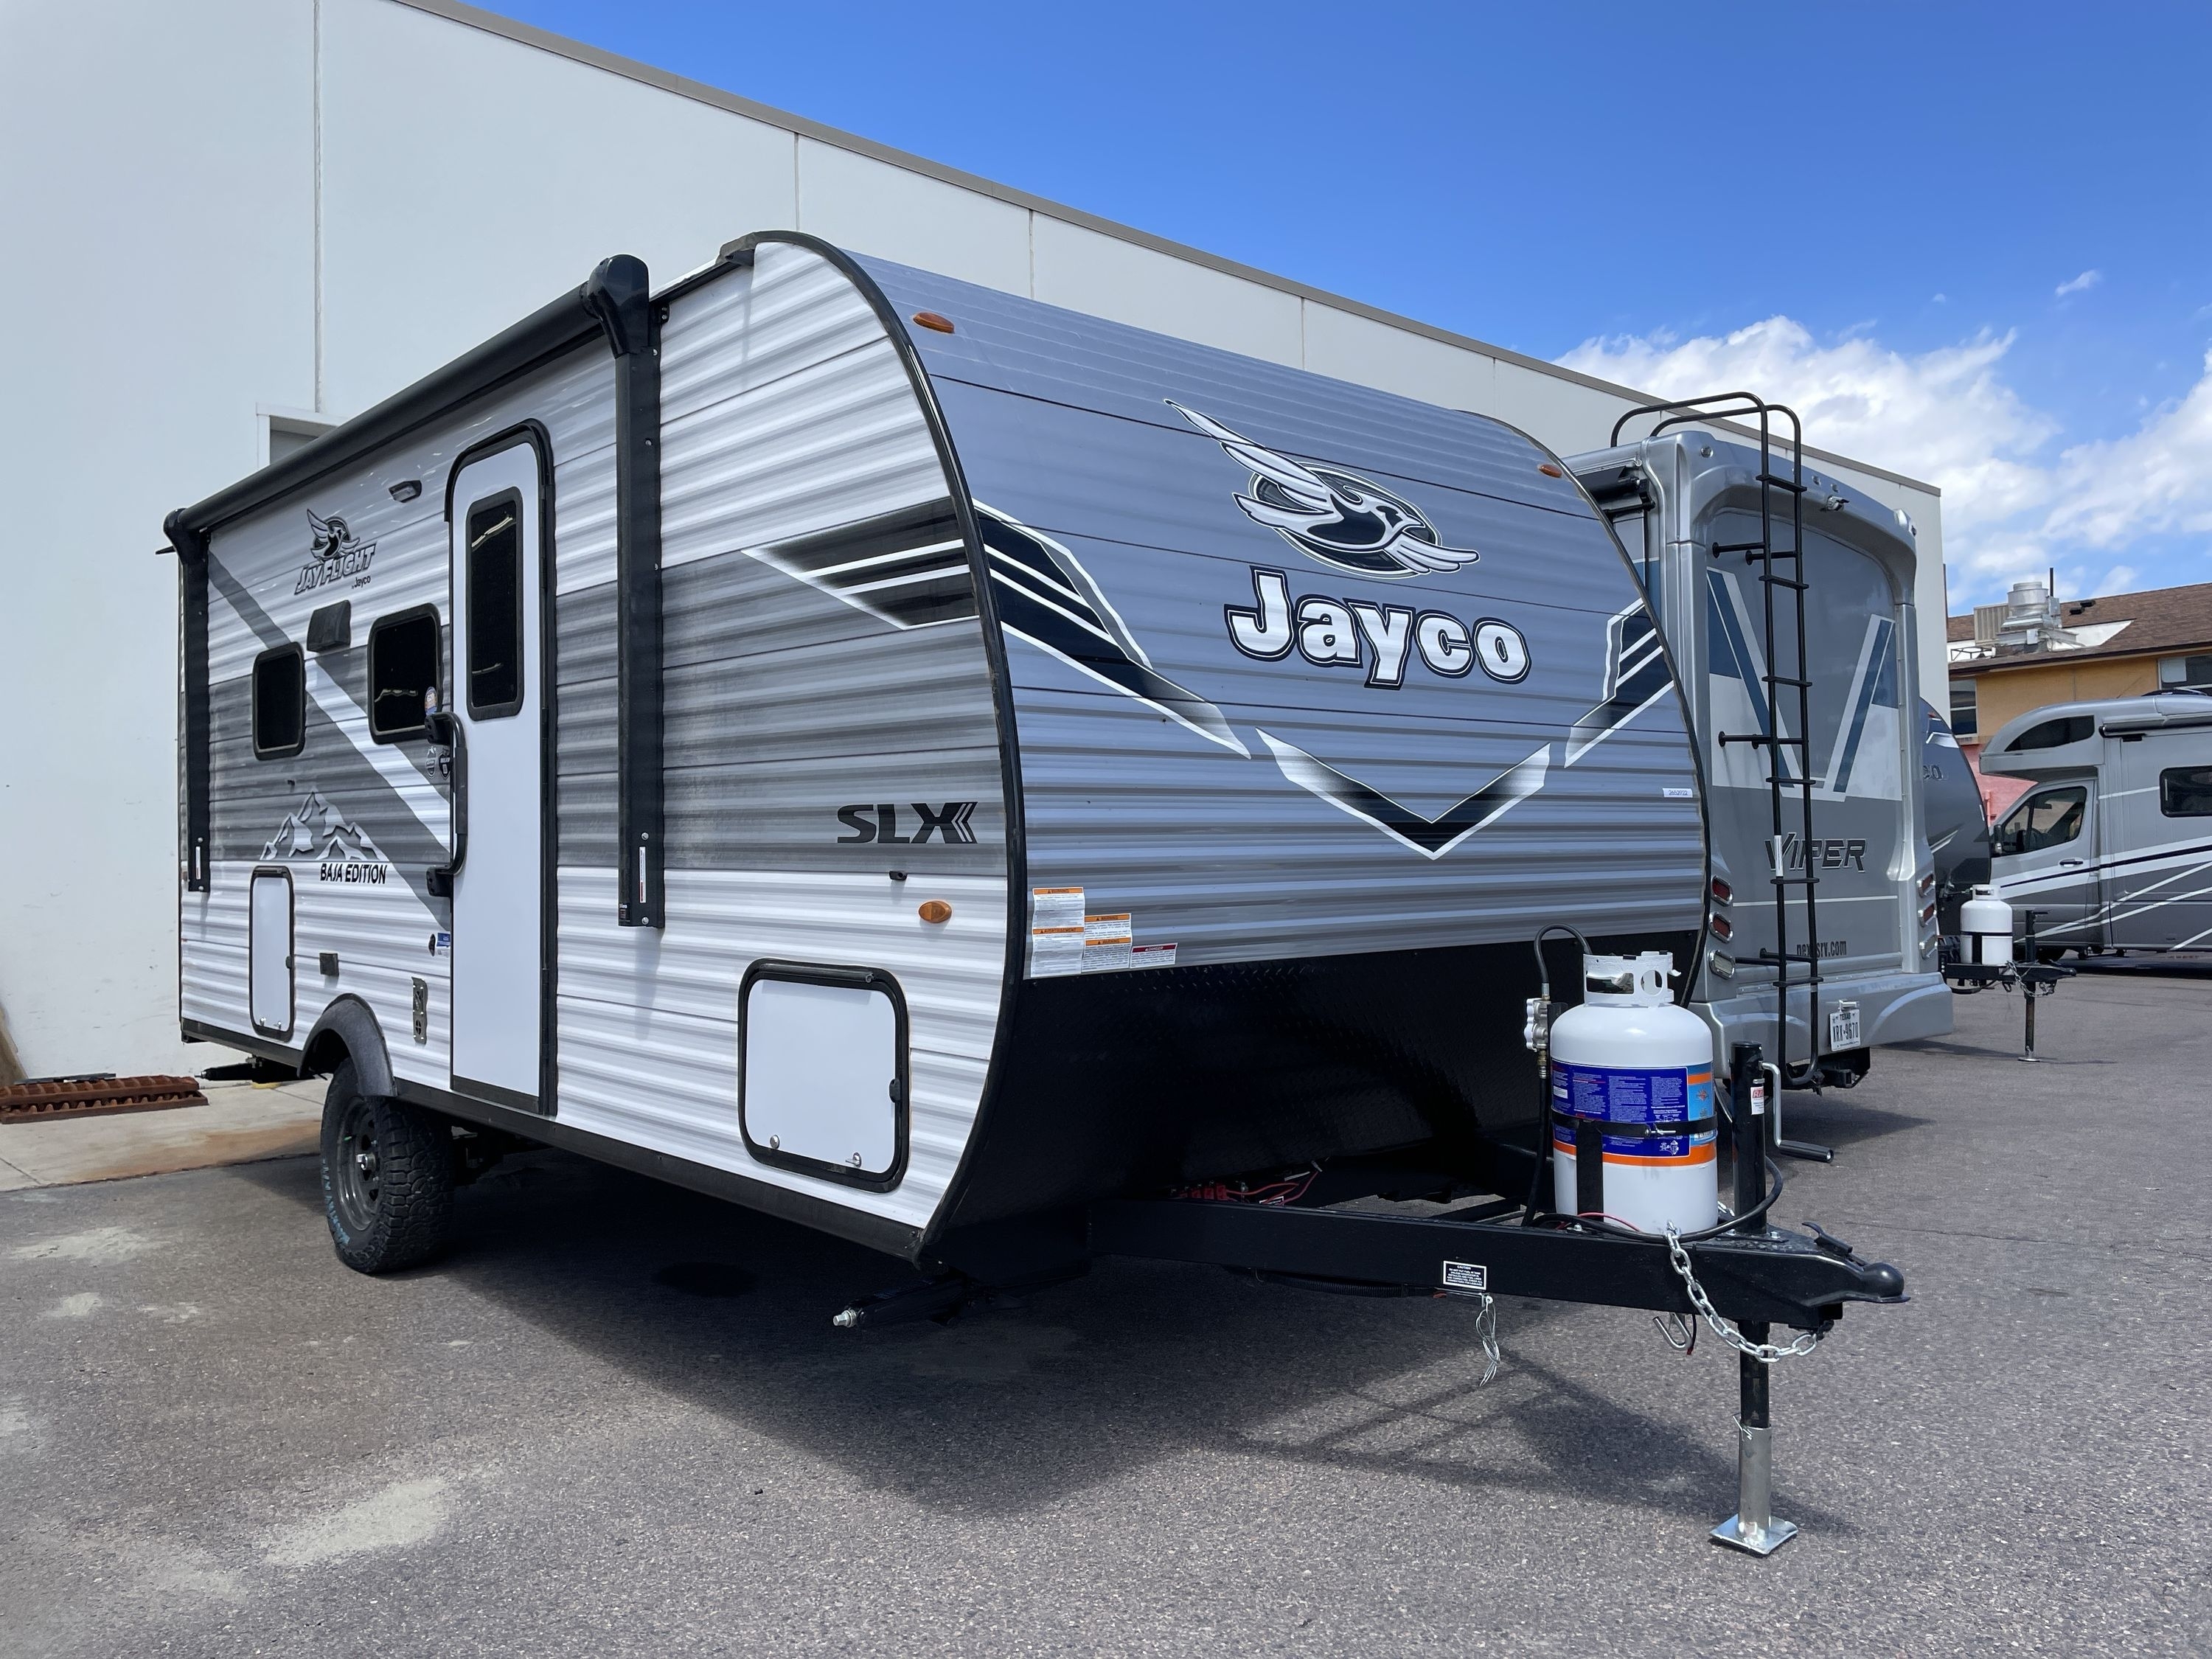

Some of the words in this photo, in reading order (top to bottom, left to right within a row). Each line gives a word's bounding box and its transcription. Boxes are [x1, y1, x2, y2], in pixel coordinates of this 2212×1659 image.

[294, 563, 325, 595] JAY
[320, 543, 377, 587] FLIGHT
[1224, 565, 1531, 690] Jayco
[838, 801, 978, 844] SLX
[1764, 832, 1866, 873] VIPER
[320, 863, 343, 882] BAJA
[345, 863, 387, 884] EDITION
[1796, 940, 1847, 957] nexsrv.com
[1840, 1012, 1851, 1020] TEXAS
